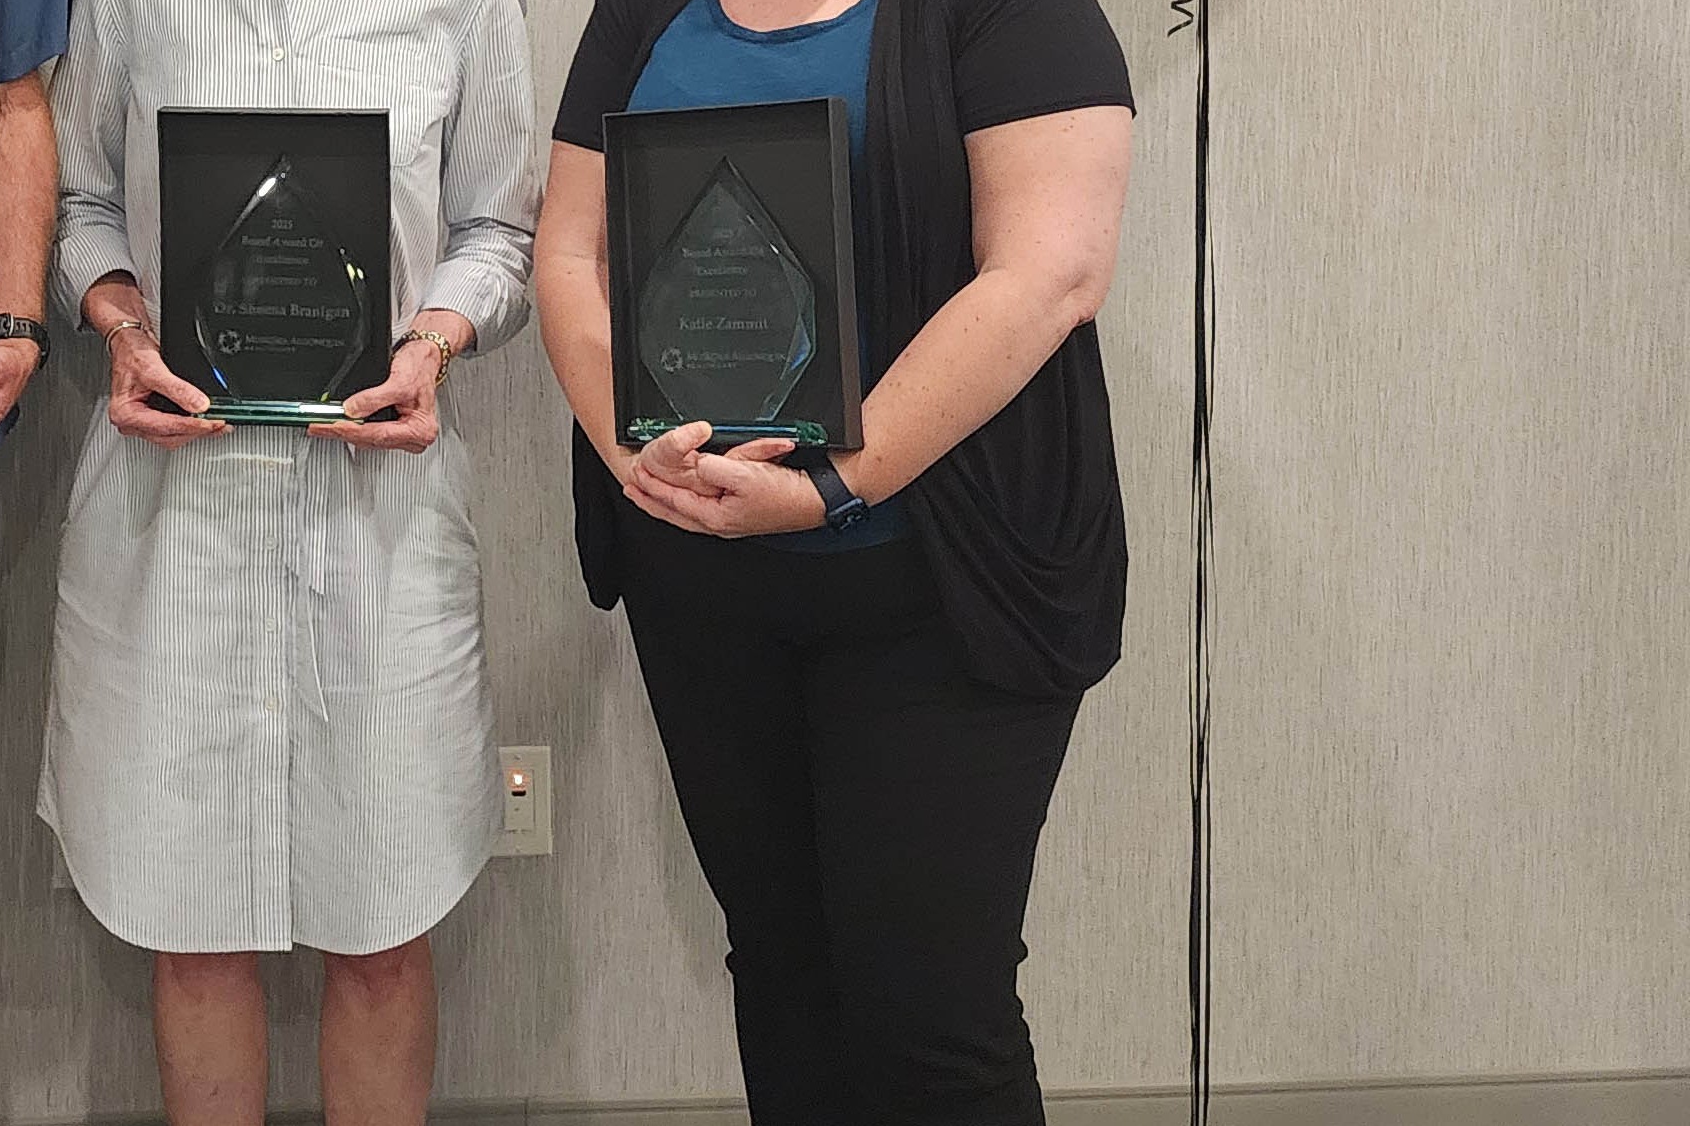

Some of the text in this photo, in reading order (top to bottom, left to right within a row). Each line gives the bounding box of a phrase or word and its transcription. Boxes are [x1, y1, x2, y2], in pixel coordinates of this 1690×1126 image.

[214, 303, 235, 315] Dr.
[289, 303, 350, 321] Branigan
[679, 316, 713, 331] Katie
